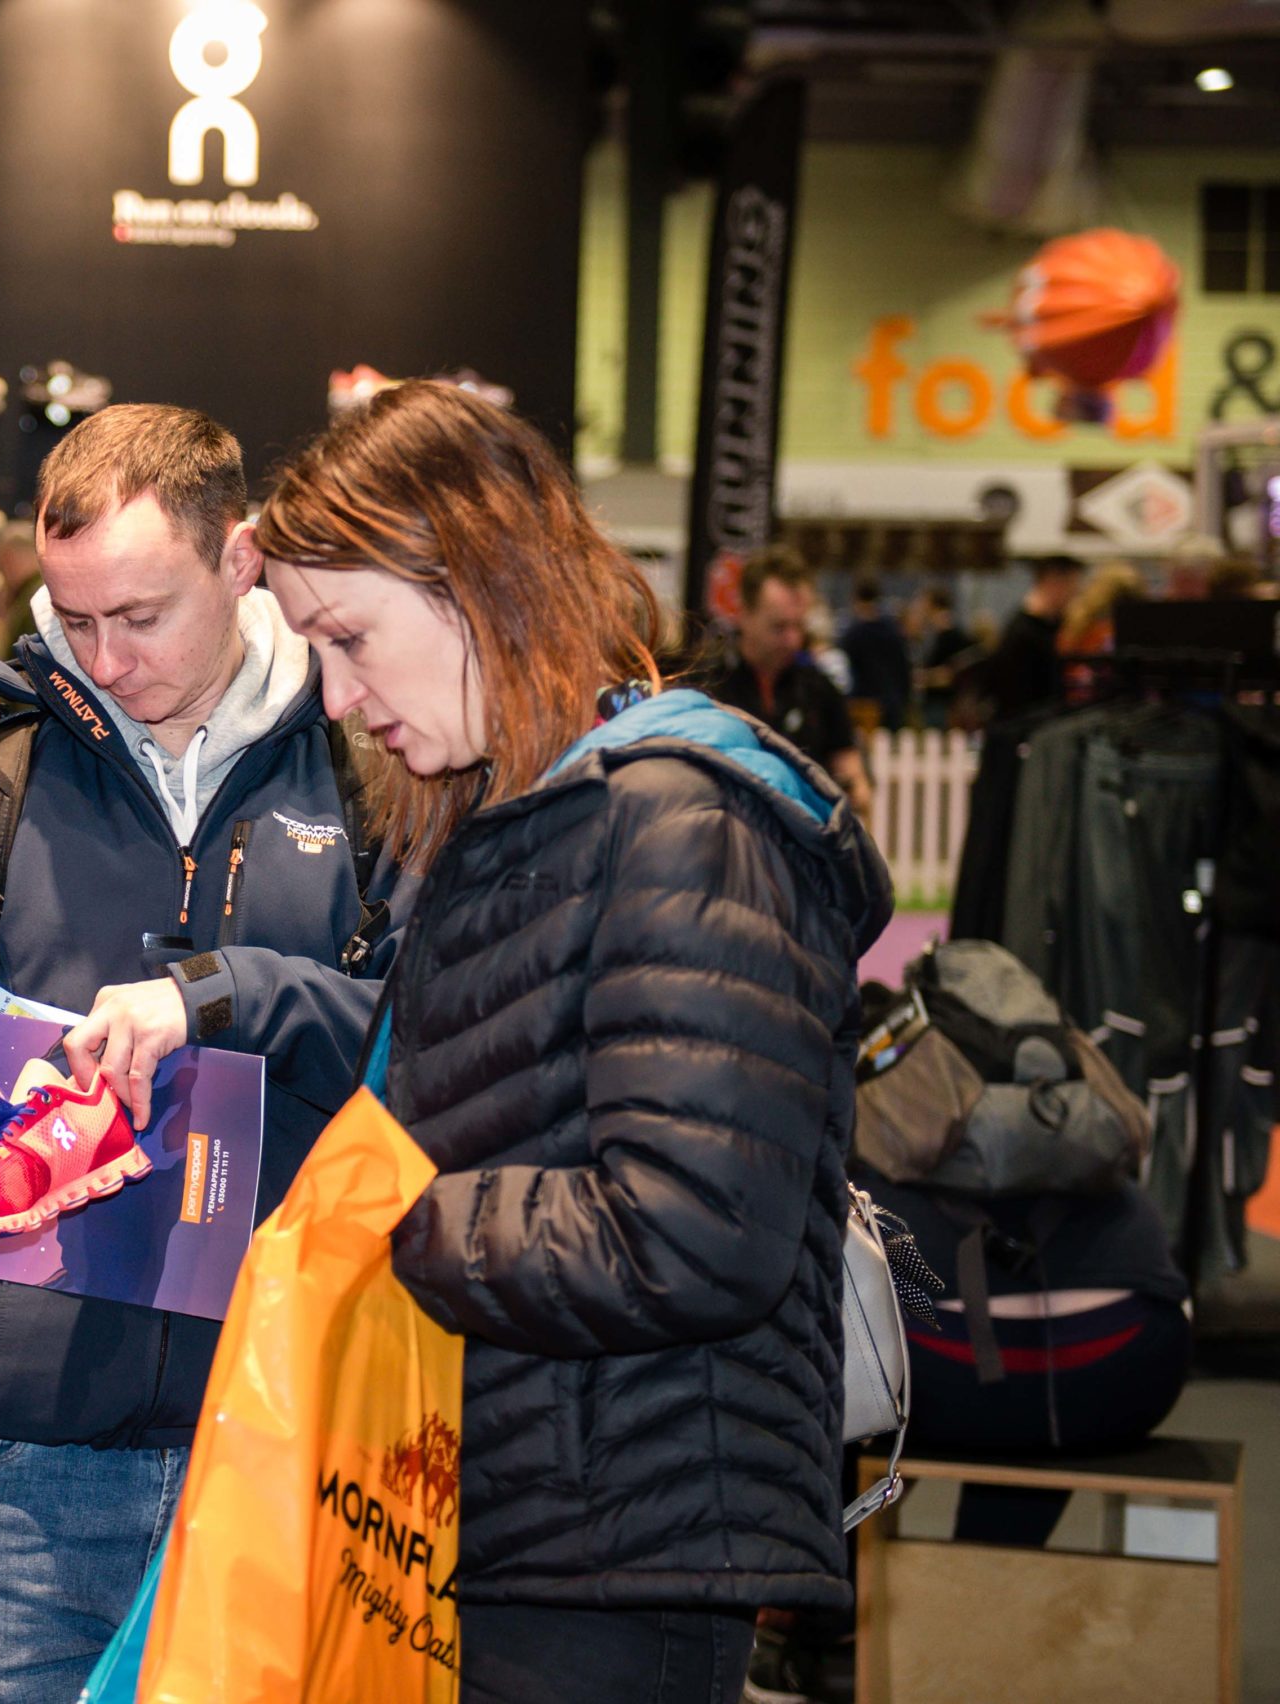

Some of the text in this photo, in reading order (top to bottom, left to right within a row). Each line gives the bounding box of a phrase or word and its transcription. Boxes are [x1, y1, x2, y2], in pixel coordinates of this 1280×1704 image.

[48, 670, 110, 741] PLATINUM
[286, 823, 337, 839] NORWAY
[186, 1139, 202, 1217] pennyappeal
[207, 1138, 221, 1214] PENNYAPPEAL.ORG
[339, 1547, 409, 1645] Mighty
